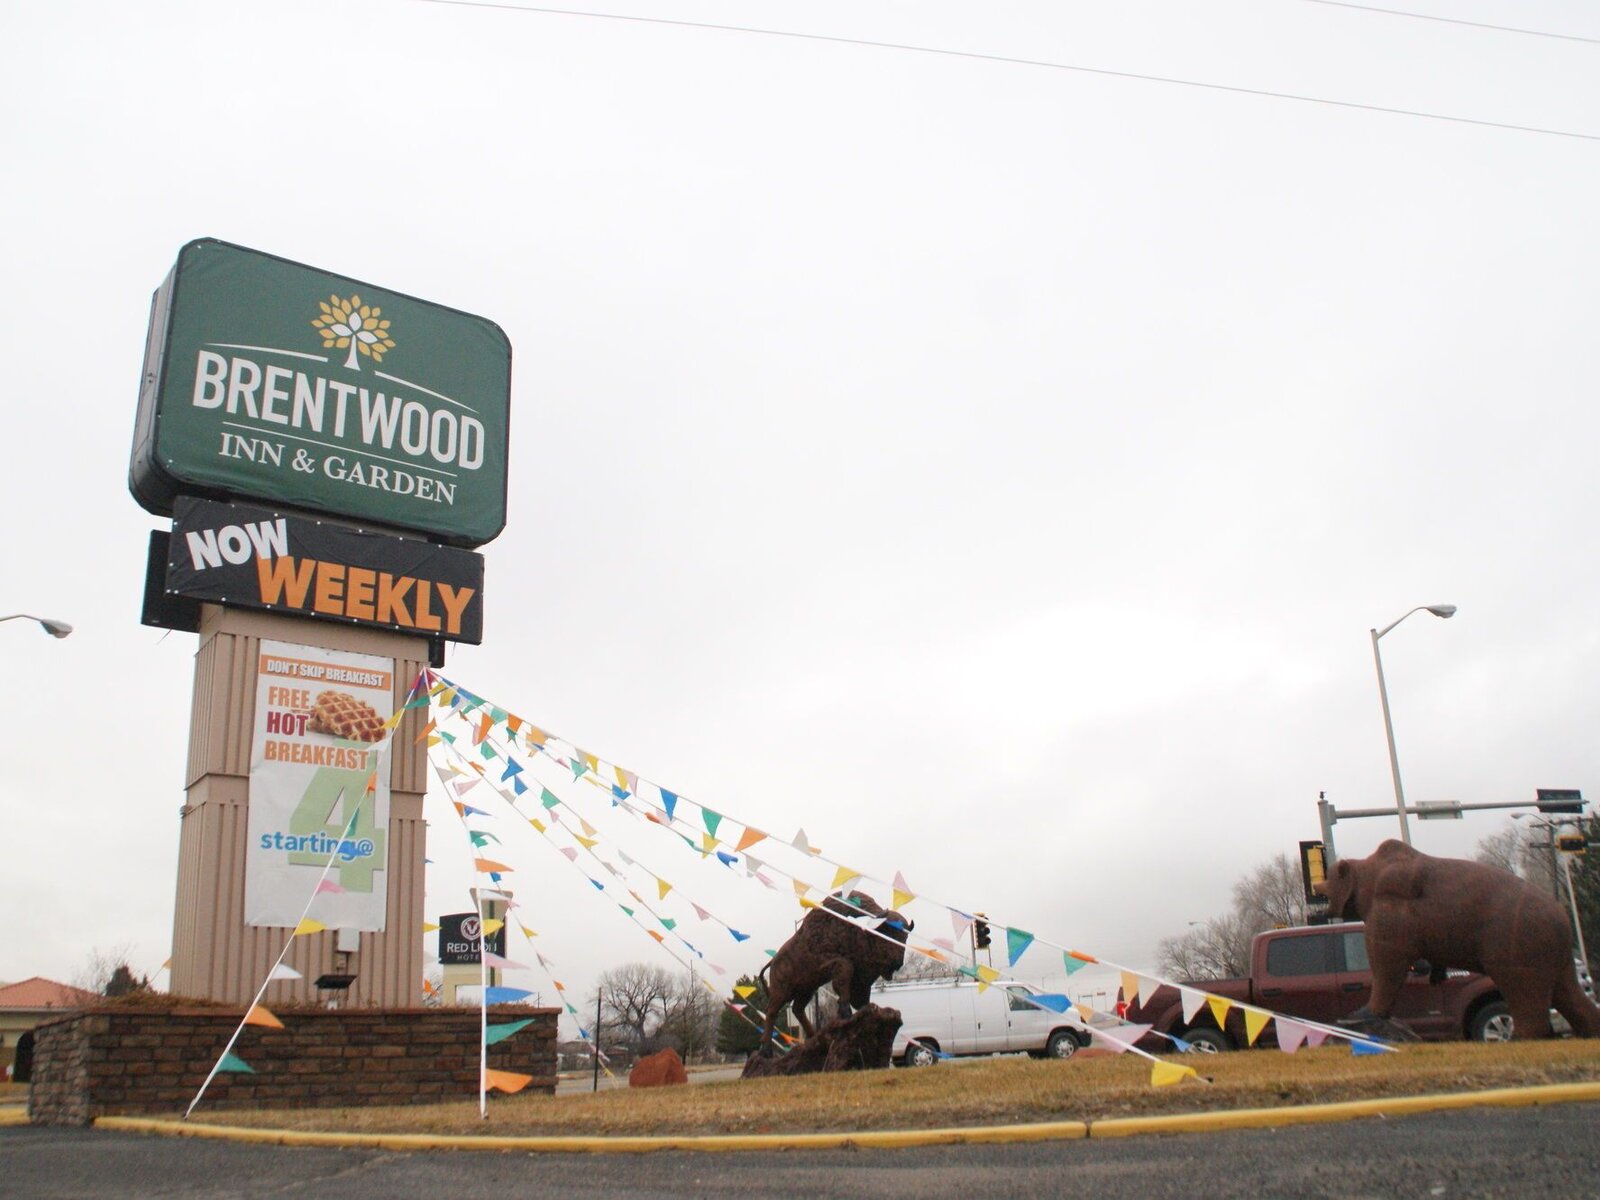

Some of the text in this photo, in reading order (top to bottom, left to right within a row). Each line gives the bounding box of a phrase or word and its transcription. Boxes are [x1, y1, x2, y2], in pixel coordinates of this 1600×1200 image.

[192, 350, 485, 470] BRENTWOOD
[218, 432, 457, 505] INN & GARDEN
[185, 518, 288, 571] NOW
[256, 554, 475, 634] WEEKLY
[267, 659, 384, 687] DON'T SKIP BREAKFAST
[268, 686, 310, 709] FREE
[266, 711, 309, 737] HOT
[264, 740, 369, 770] BREAKFAST
[288, 738, 385, 893] 4
[446, 942, 469, 953] RED
[457, 953, 482, 961] HOTE
